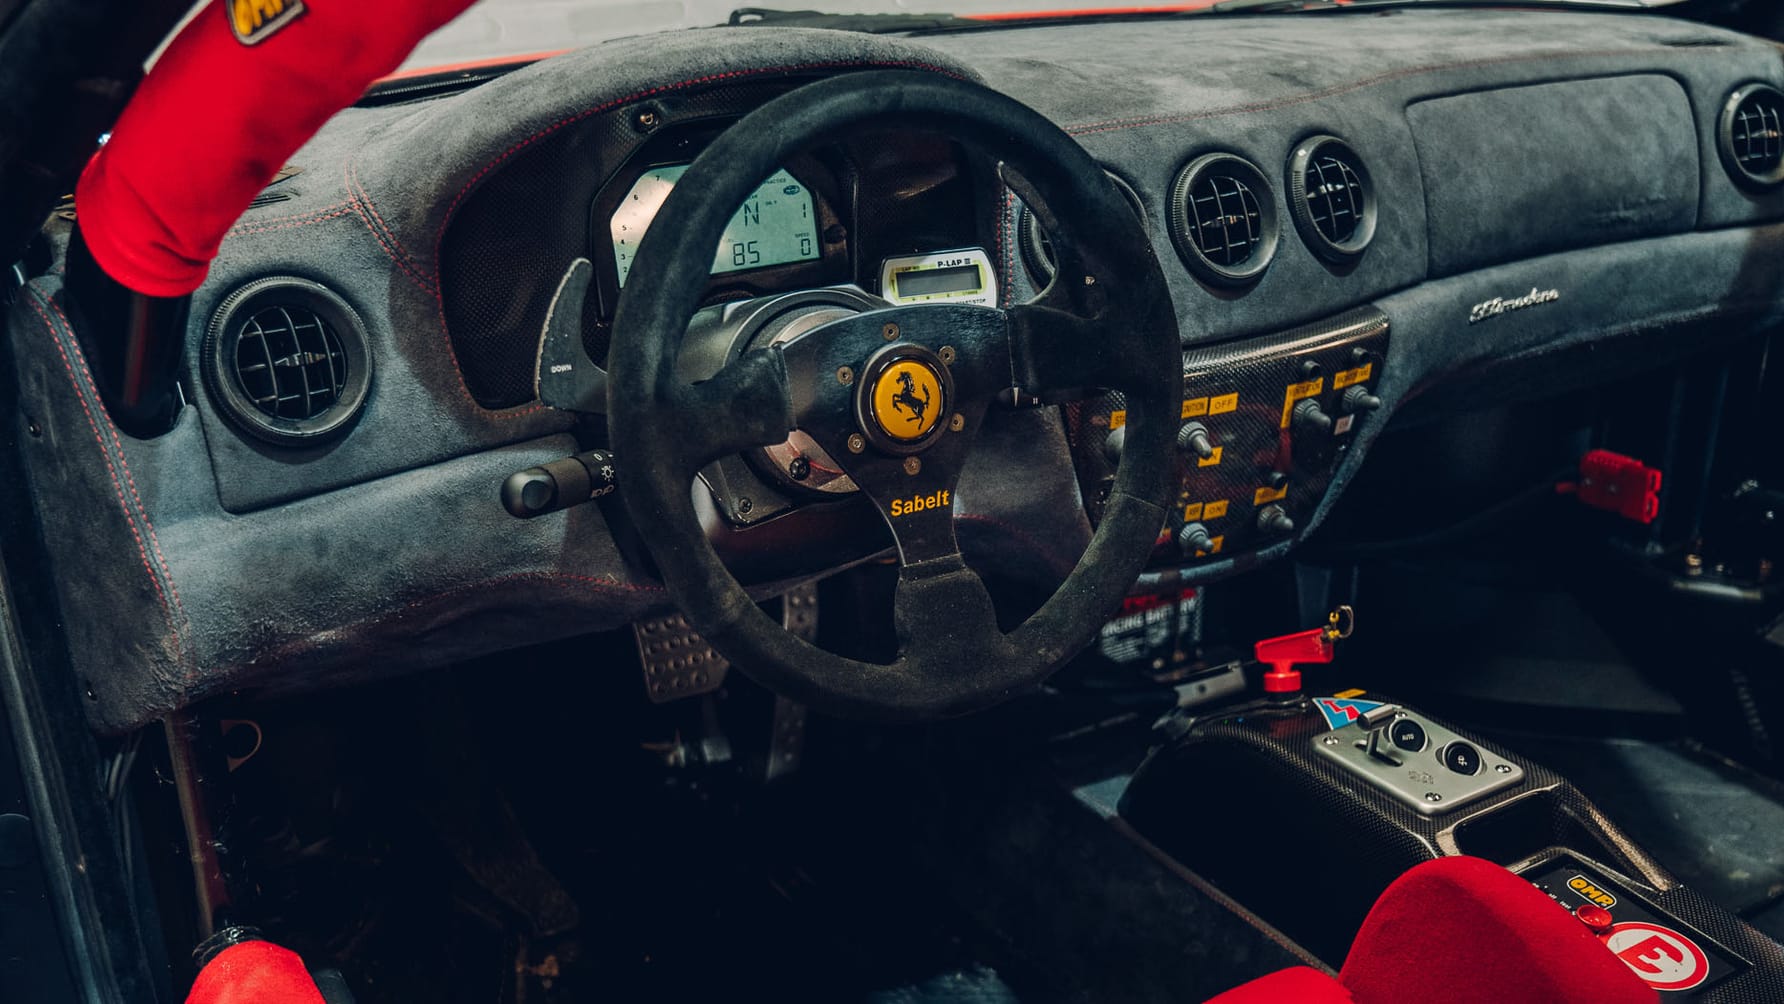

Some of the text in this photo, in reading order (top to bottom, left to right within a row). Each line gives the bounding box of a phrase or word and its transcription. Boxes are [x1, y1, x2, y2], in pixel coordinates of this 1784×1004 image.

[744, 202, 760, 227] N
[802, 203, 807, 218] 1
[733, 238, 811, 266] 85 0
[937, 258, 963, 268] P-LAP
[551, 363, 572, 374] DOWN
[1214, 398, 1233, 410] OFF
[891, 490, 949, 517] Sabelt
[1569, 878, 1615, 907] OMP
